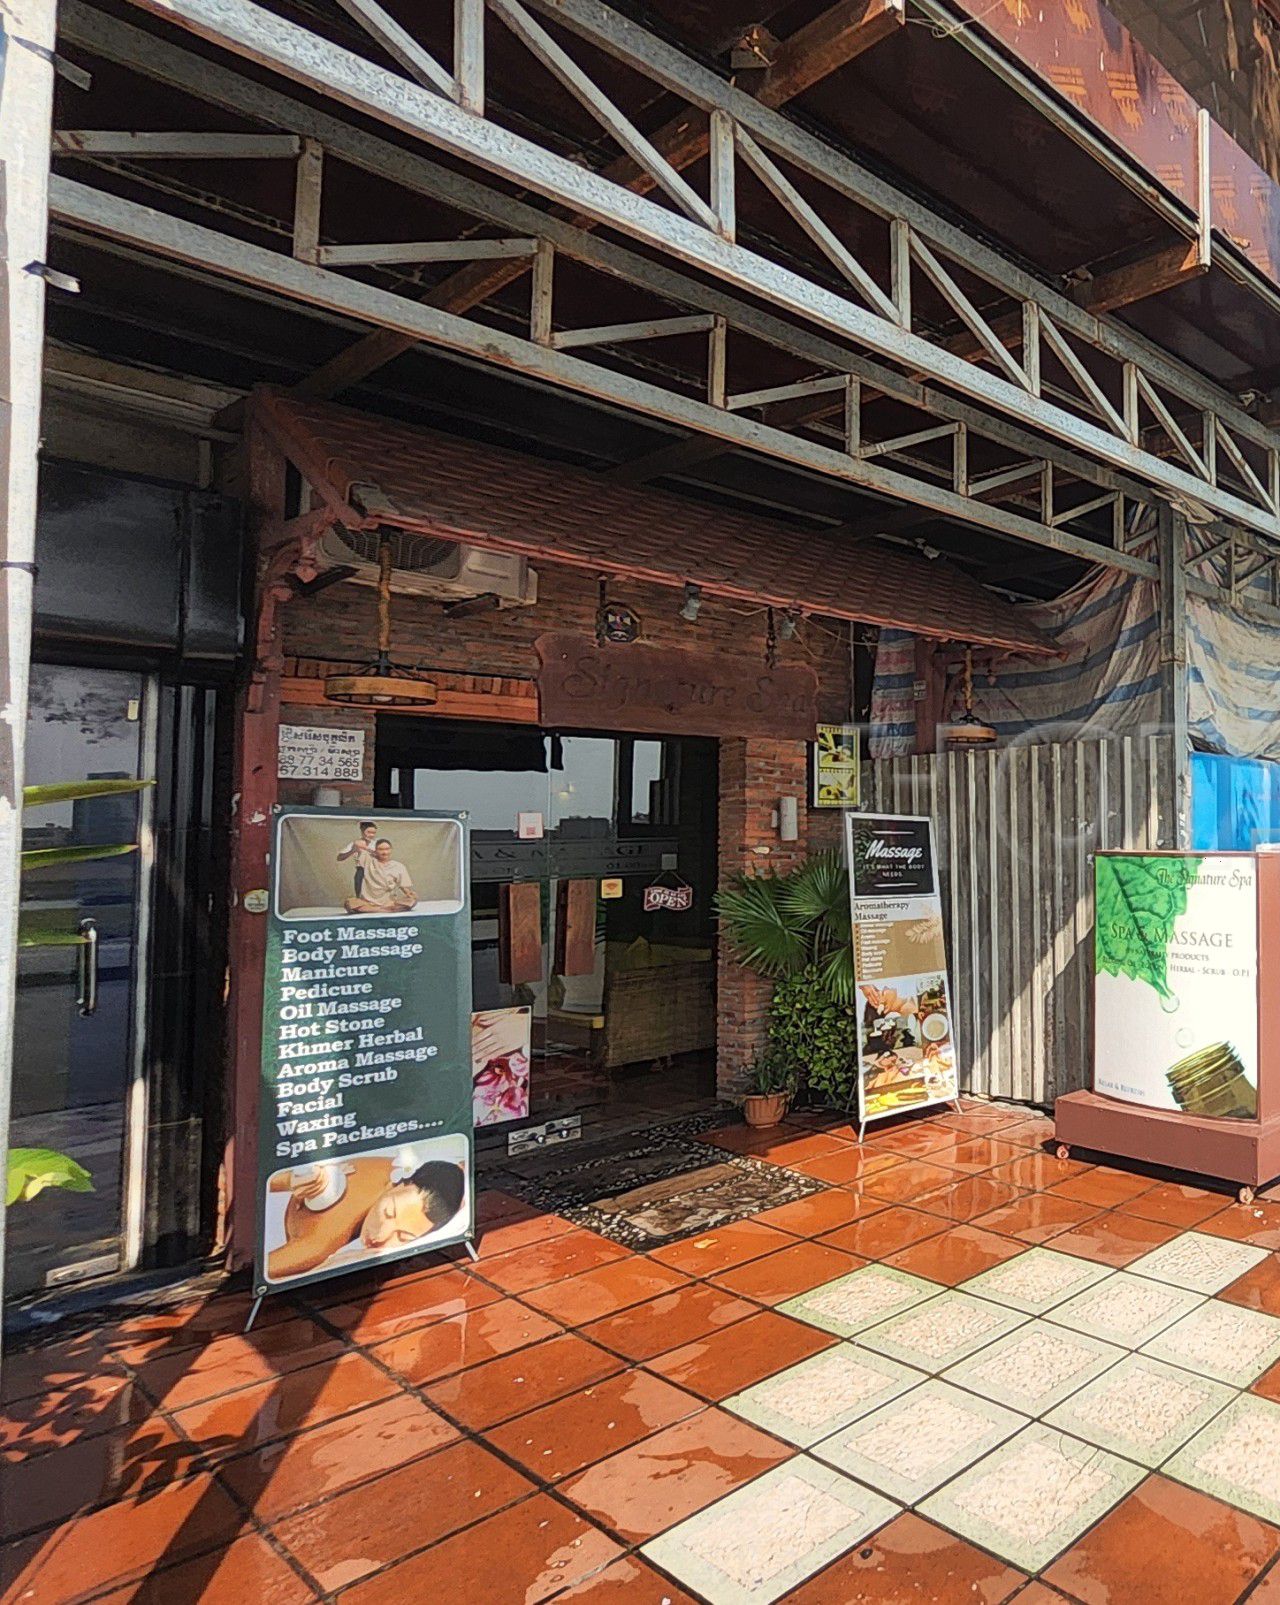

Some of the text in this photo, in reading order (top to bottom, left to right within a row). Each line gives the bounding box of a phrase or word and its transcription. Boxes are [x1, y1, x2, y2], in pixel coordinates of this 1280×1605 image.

[302, 766, 329, 777] 314
[334, 767, 359, 778] 888
[865, 839, 923, 864] Massage
[1228, 868, 1252, 890] Spa
[650, 893, 687, 908] OPEN
[855, 901, 909, 911] Aromatherapy
[855, 912, 888, 921] Massage
[282, 925, 419, 945] Foot Massage
[281, 942, 423, 964] Body Massage
[280, 963, 380, 982] Manicure
[280, 982, 373, 1001] Pedicure
[279, 997, 402, 1020] Oil Massage
[279, 1017, 386, 1040] Hot Stone
[278, 1027, 424, 1060] Khmer Herbal
[276, 1046, 439, 1079] Aroma Massage
[276, 1067, 398, 1099] Body Scrub
[276, 1093, 344, 1118] Facial
[276, 1112, 357, 1137] Waxing
[275, 1138, 318, 1158] Spa
